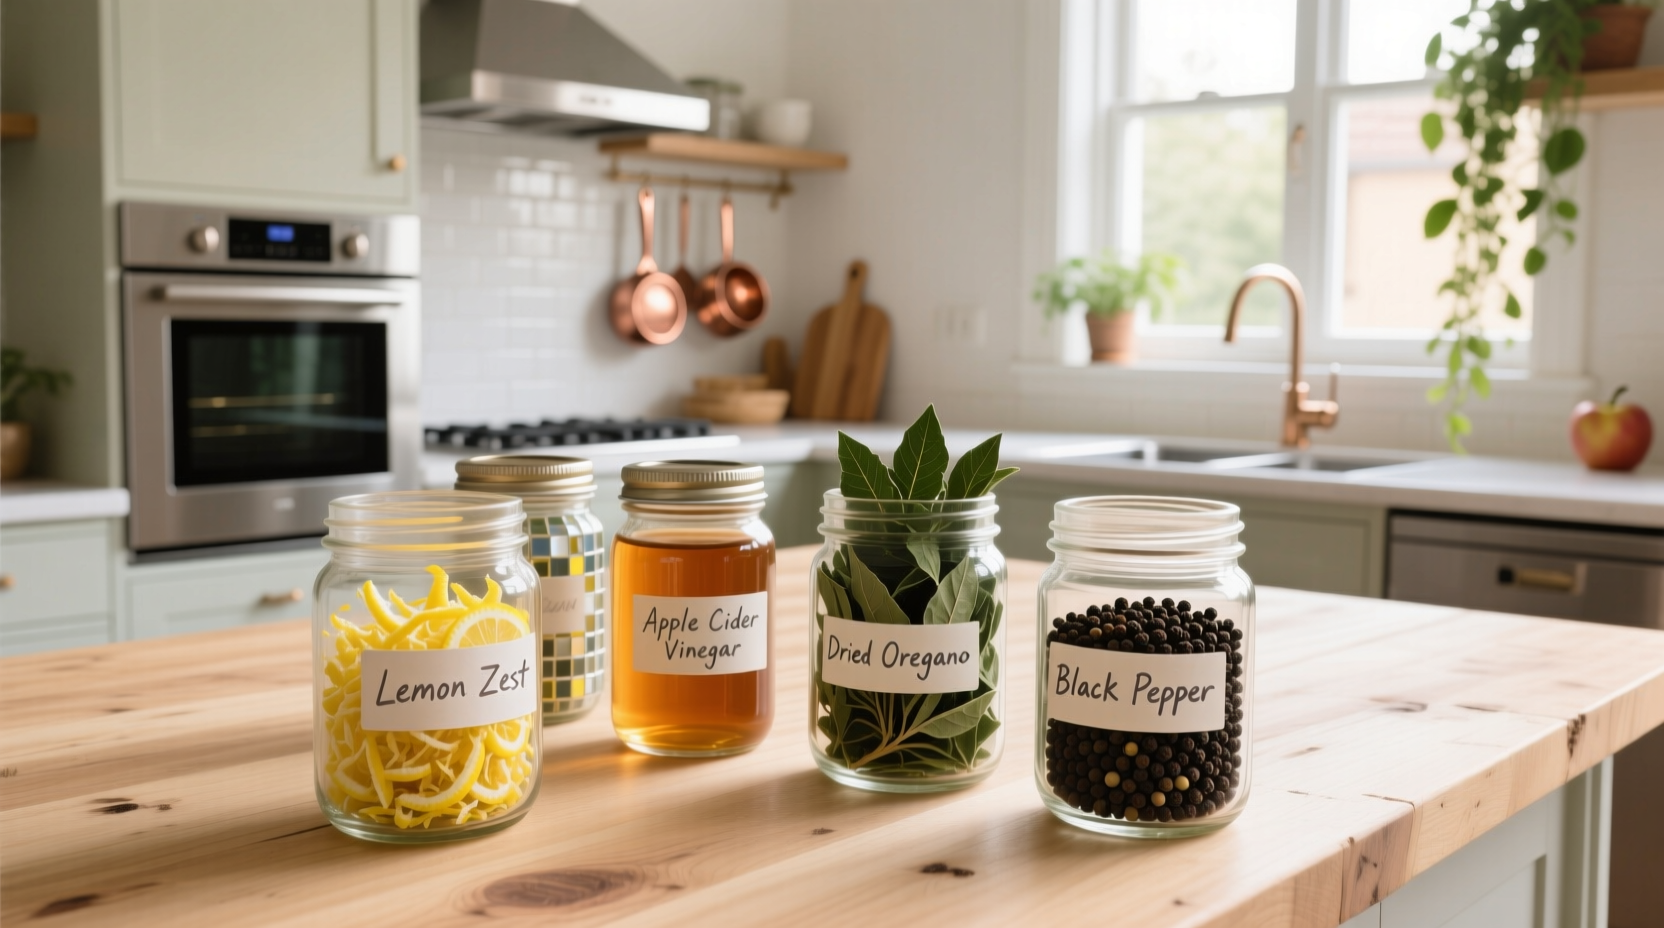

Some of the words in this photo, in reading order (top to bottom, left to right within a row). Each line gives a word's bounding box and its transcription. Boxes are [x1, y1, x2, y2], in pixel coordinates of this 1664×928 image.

[642, 606, 700, 642] Apple
[708, 605, 760, 631] Cider
[664, 640, 742, 671] Vinegar
[827, 634, 872, 667] Dried
[881, 640, 971, 682] Oregano
[375, 668, 467, 707] Lemon
[478, 658, 531, 698] Zest
[1055, 663, 1119, 702] Black
[1131, 671, 1216, 717] Pepper
